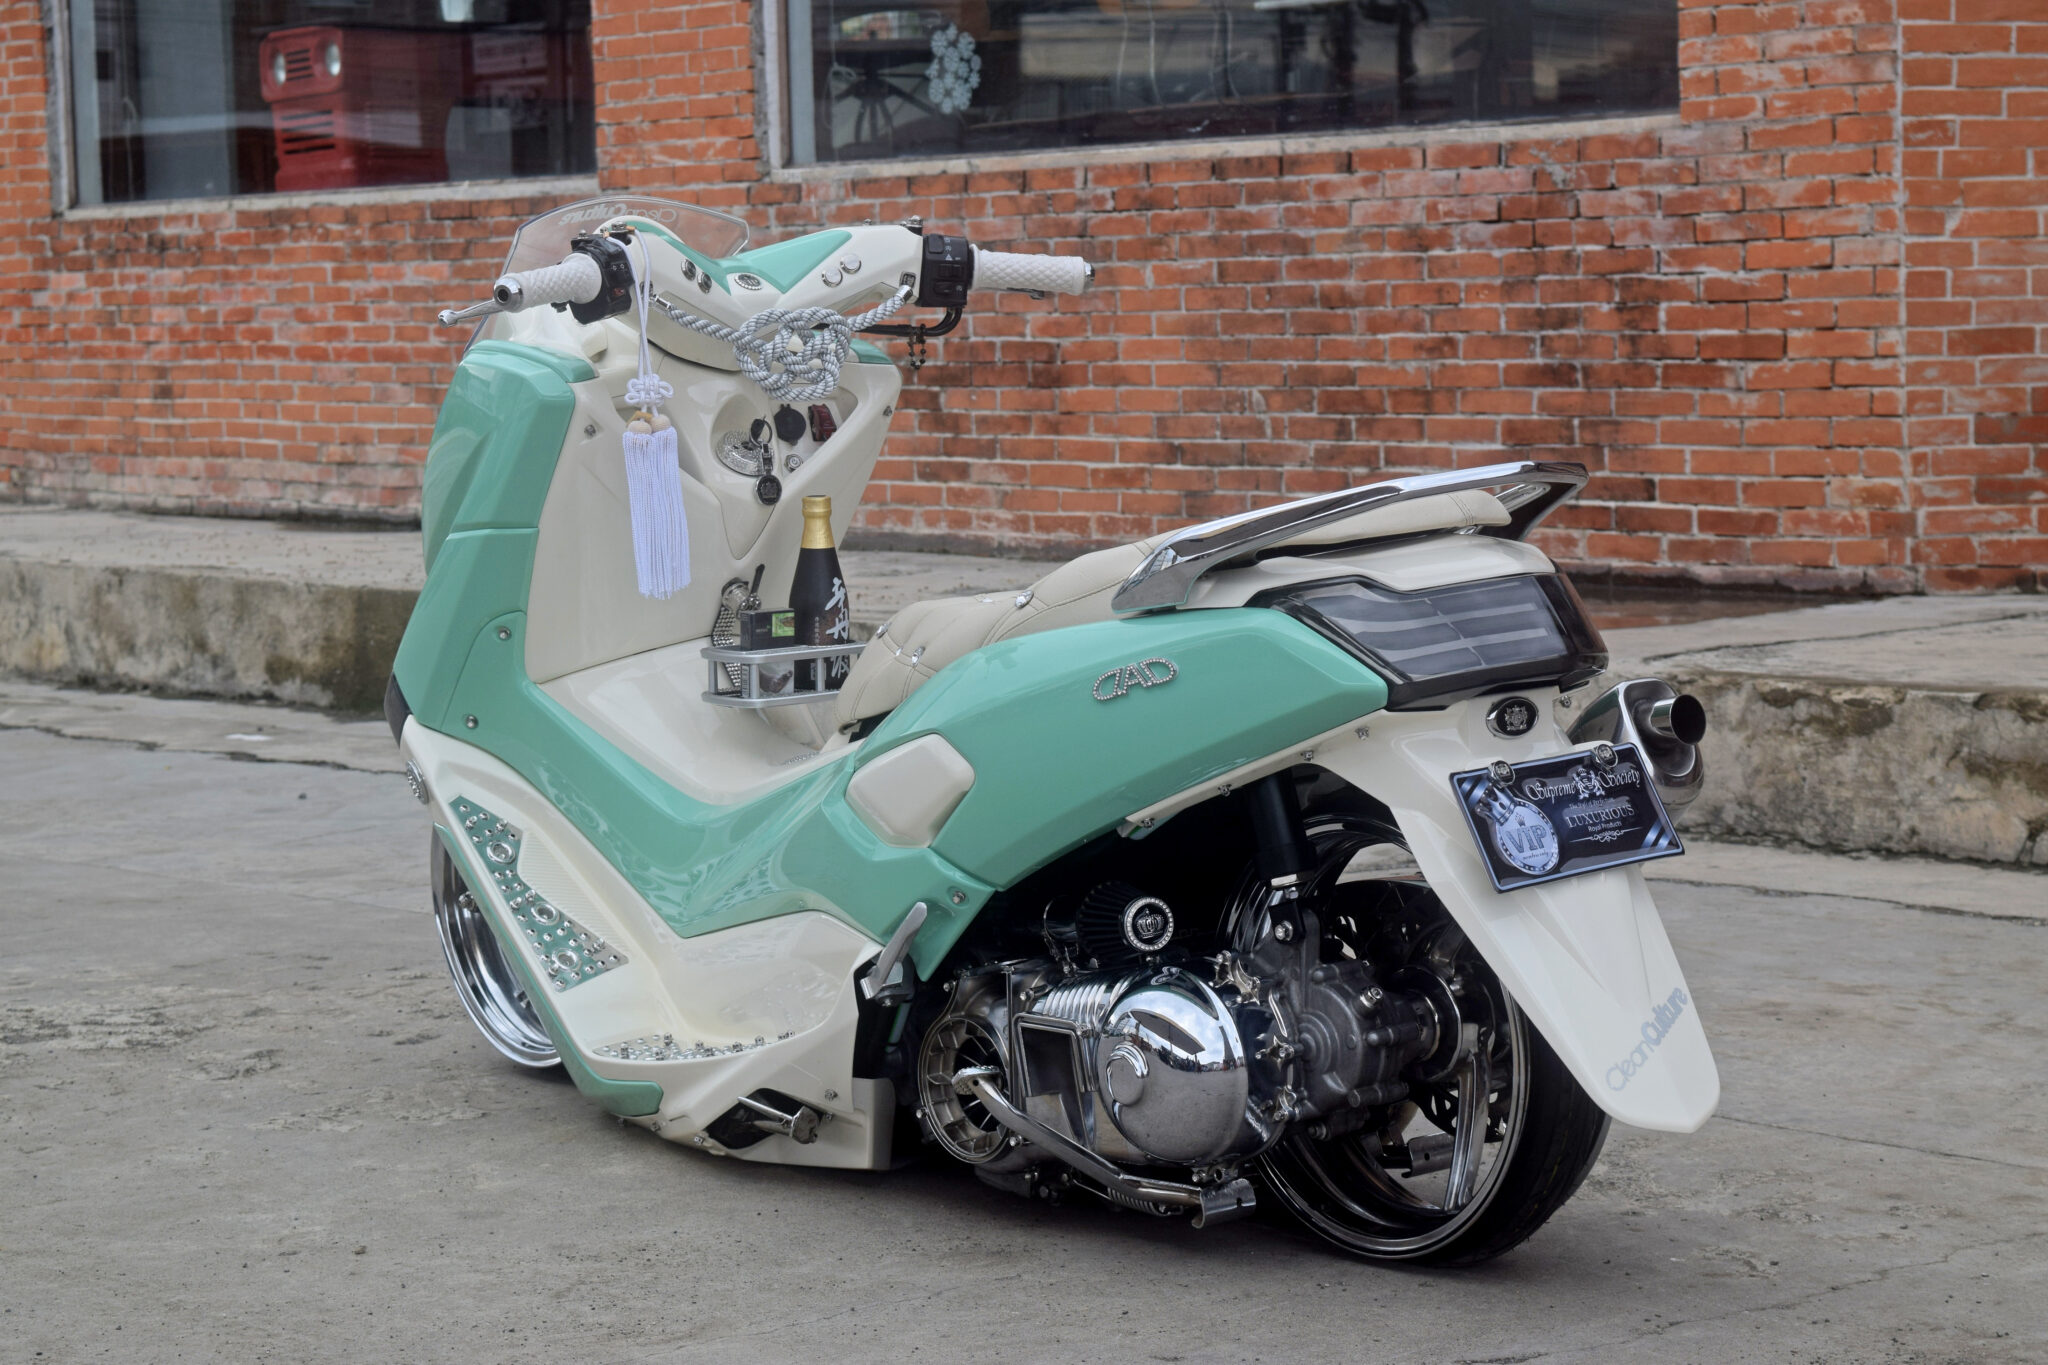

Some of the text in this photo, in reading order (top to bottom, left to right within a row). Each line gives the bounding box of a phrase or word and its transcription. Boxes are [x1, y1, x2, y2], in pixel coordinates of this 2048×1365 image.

[1525, 781, 1576, 804] Supreme
[1597, 768, 1641, 788] Society
[1565, 804, 1635, 828] LUXURIOUS
[1587, 823, 1602, 833] Royal
[1504, 824, 1547, 854] VIP
